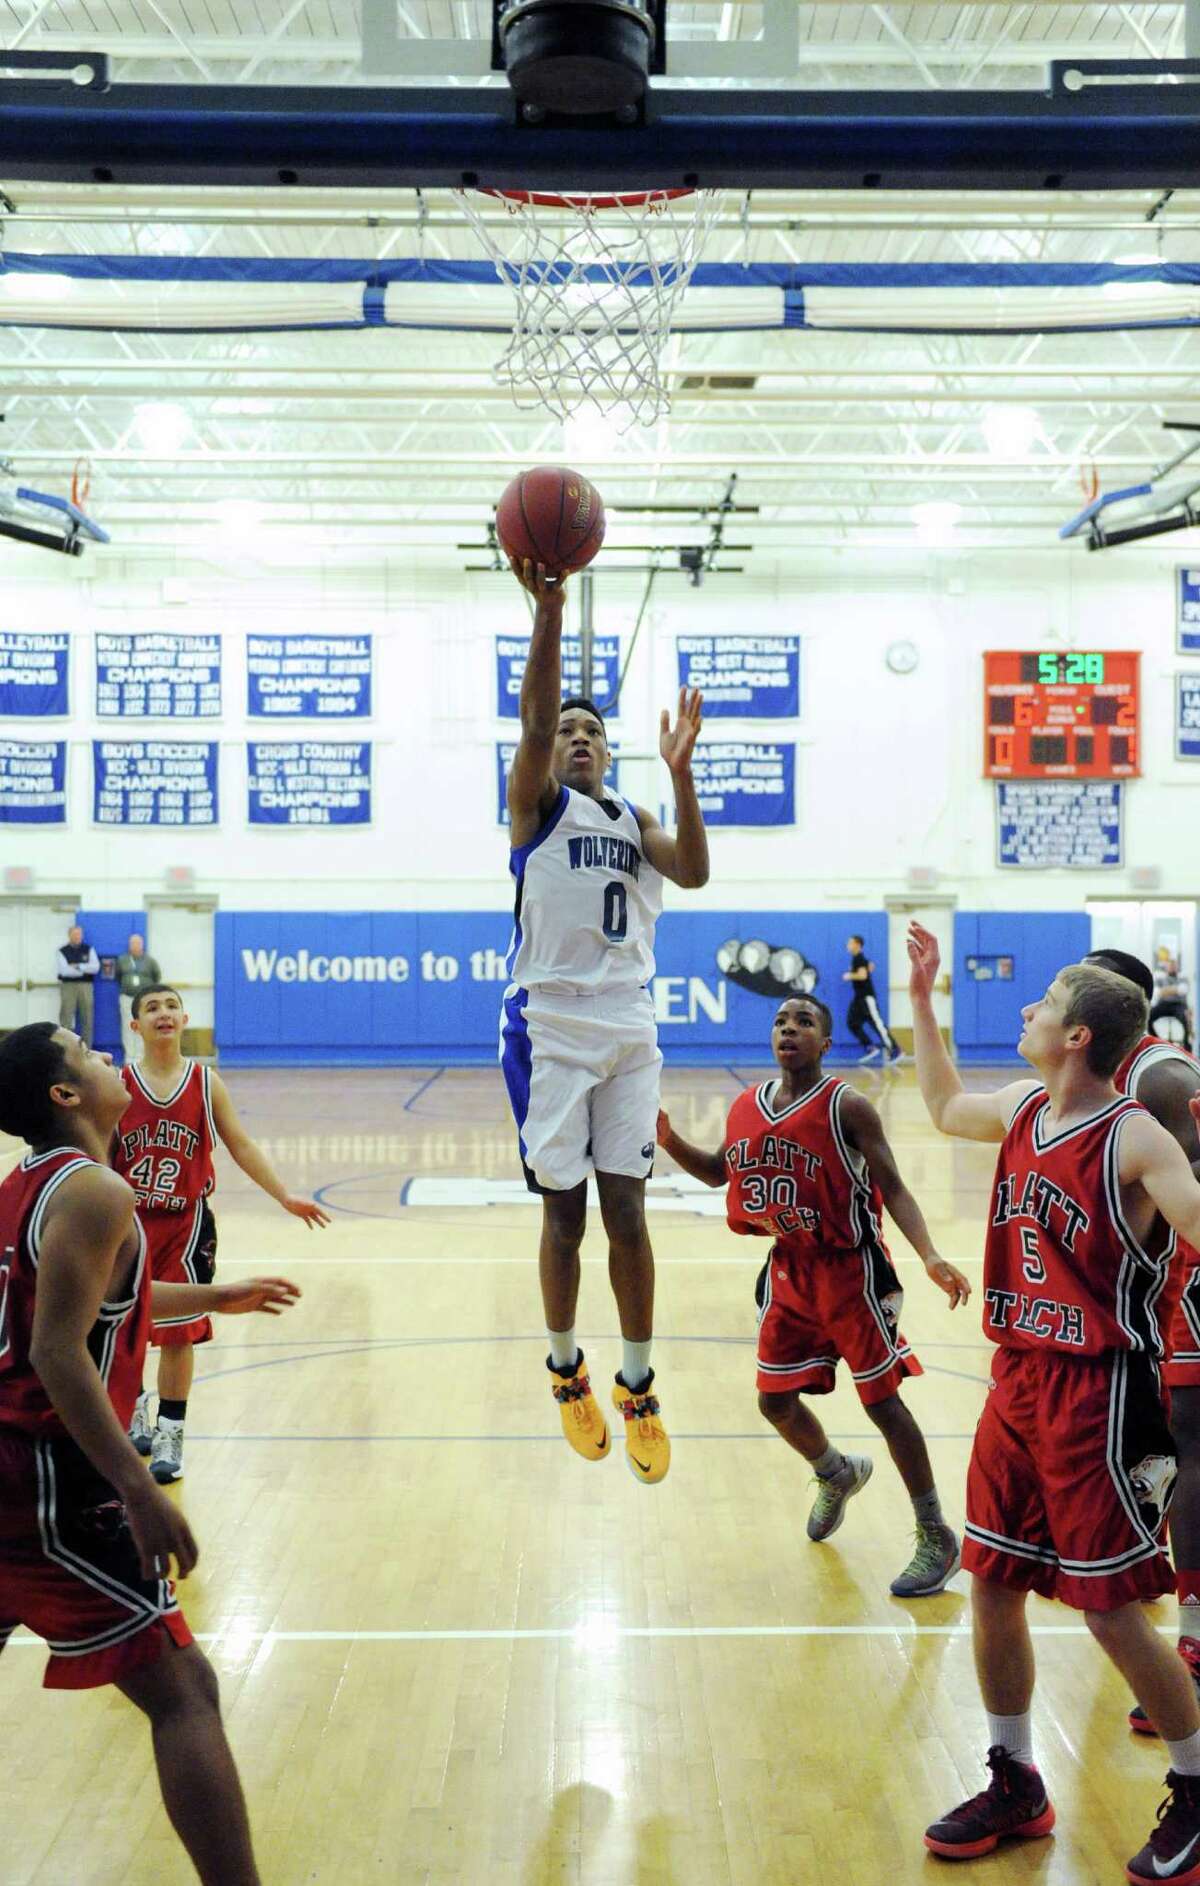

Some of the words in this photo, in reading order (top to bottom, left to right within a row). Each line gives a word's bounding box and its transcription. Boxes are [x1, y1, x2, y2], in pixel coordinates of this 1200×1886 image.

[108, 668, 210, 683] CHAMPIONS
[260, 679, 360, 693] CHAMPIONS
[689, 672, 789, 687] CHAMPIONS
[105, 776, 208, 790] CHAMPIONS
[260, 792, 359, 807] CHAMPIONS
[602, 881, 628, 942] 0
[241, 949, 408, 983] Welcome
[421, 951, 459, 982] to
[469, 949, 508, 982] th
[655, 976, 726, 1024] EN
[122, 1119, 199, 1161] PLATT
[129, 1155, 181, 1193] 42
[741, 1174, 797, 1214] 30
[1020, 1226, 1047, 1285] 5
